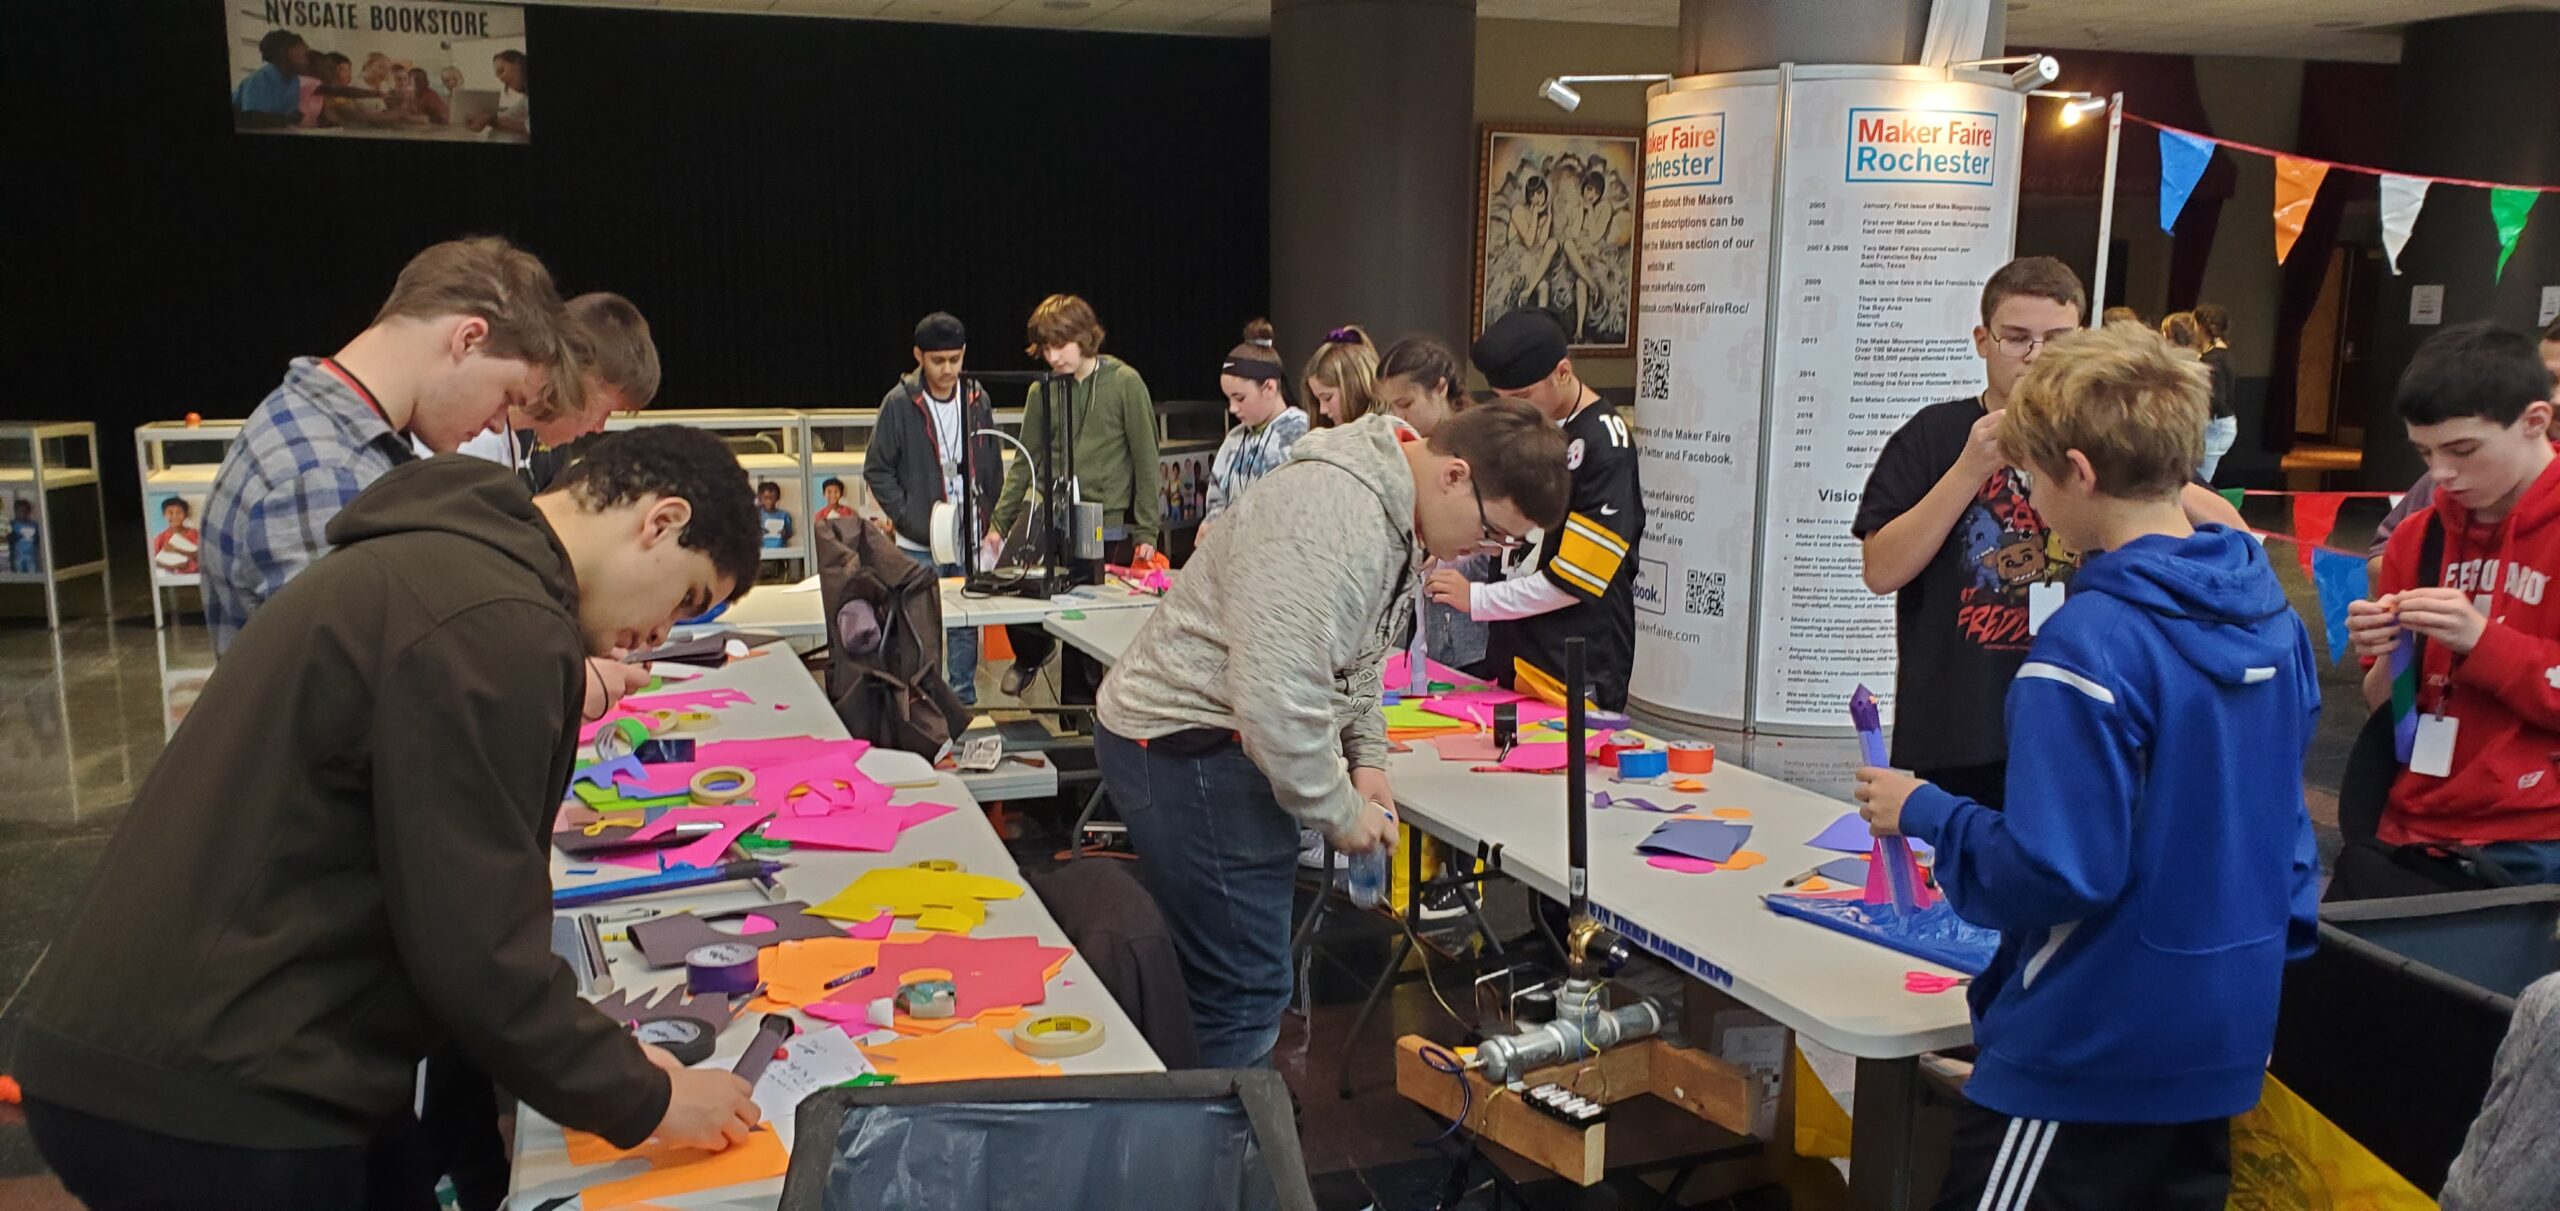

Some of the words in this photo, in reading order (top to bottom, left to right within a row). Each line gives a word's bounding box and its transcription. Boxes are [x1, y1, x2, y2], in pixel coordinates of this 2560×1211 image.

[265, 0, 358, 29] NYSCATE
[371, 6, 489, 38] BOOKSTORE
[1646, 130, 1669, 155] aker
[1671, 125, 1716, 150] Faire
[1858, 118, 1942, 144] Maker
[1948, 121, 1992, 147] Faire
[1646, 153, 1714, 181] ochester
[1857, 146, 1990, 176] Rochester
[1683, 195, 1696, 206] the
[1698, 193, 1734, 206] Makers
[1863, 202, 1892, 210] January,
[1660, 216, 1707, 230] descriptions
[1709, 217, 1728, 228] can
[1731, 215, 1744, 228] be
[1660, 240, 1684, 250] Makers
[1686, 238, 1719, 250] section
[1722, 236, 1734, 249] of
[1736, 238, 1755, 249] our
[1872, 304, 1886, 312] Bay
[1890, 321, 1904, 329] City
[1853, 379, 1884, 387] Including
[1599, 413, 1629, 449] 19
[1654, 428, 1660, 438] of
[1662, 428, 1673, 440] the
[1675, 428, 1702, 442] Maker
[1705, 430, 1732, 444] Faire
[1664, 449, 1680, 460] and
[1642, 488, 1695, 504] makerfaireroc
[1642, 531, 1684, 546] MakerFaire
[1634, 580, 1658, 602] book
[1587, 901, 1612, 925] WIN
[1697, 956, 1733, 988] EXPO
